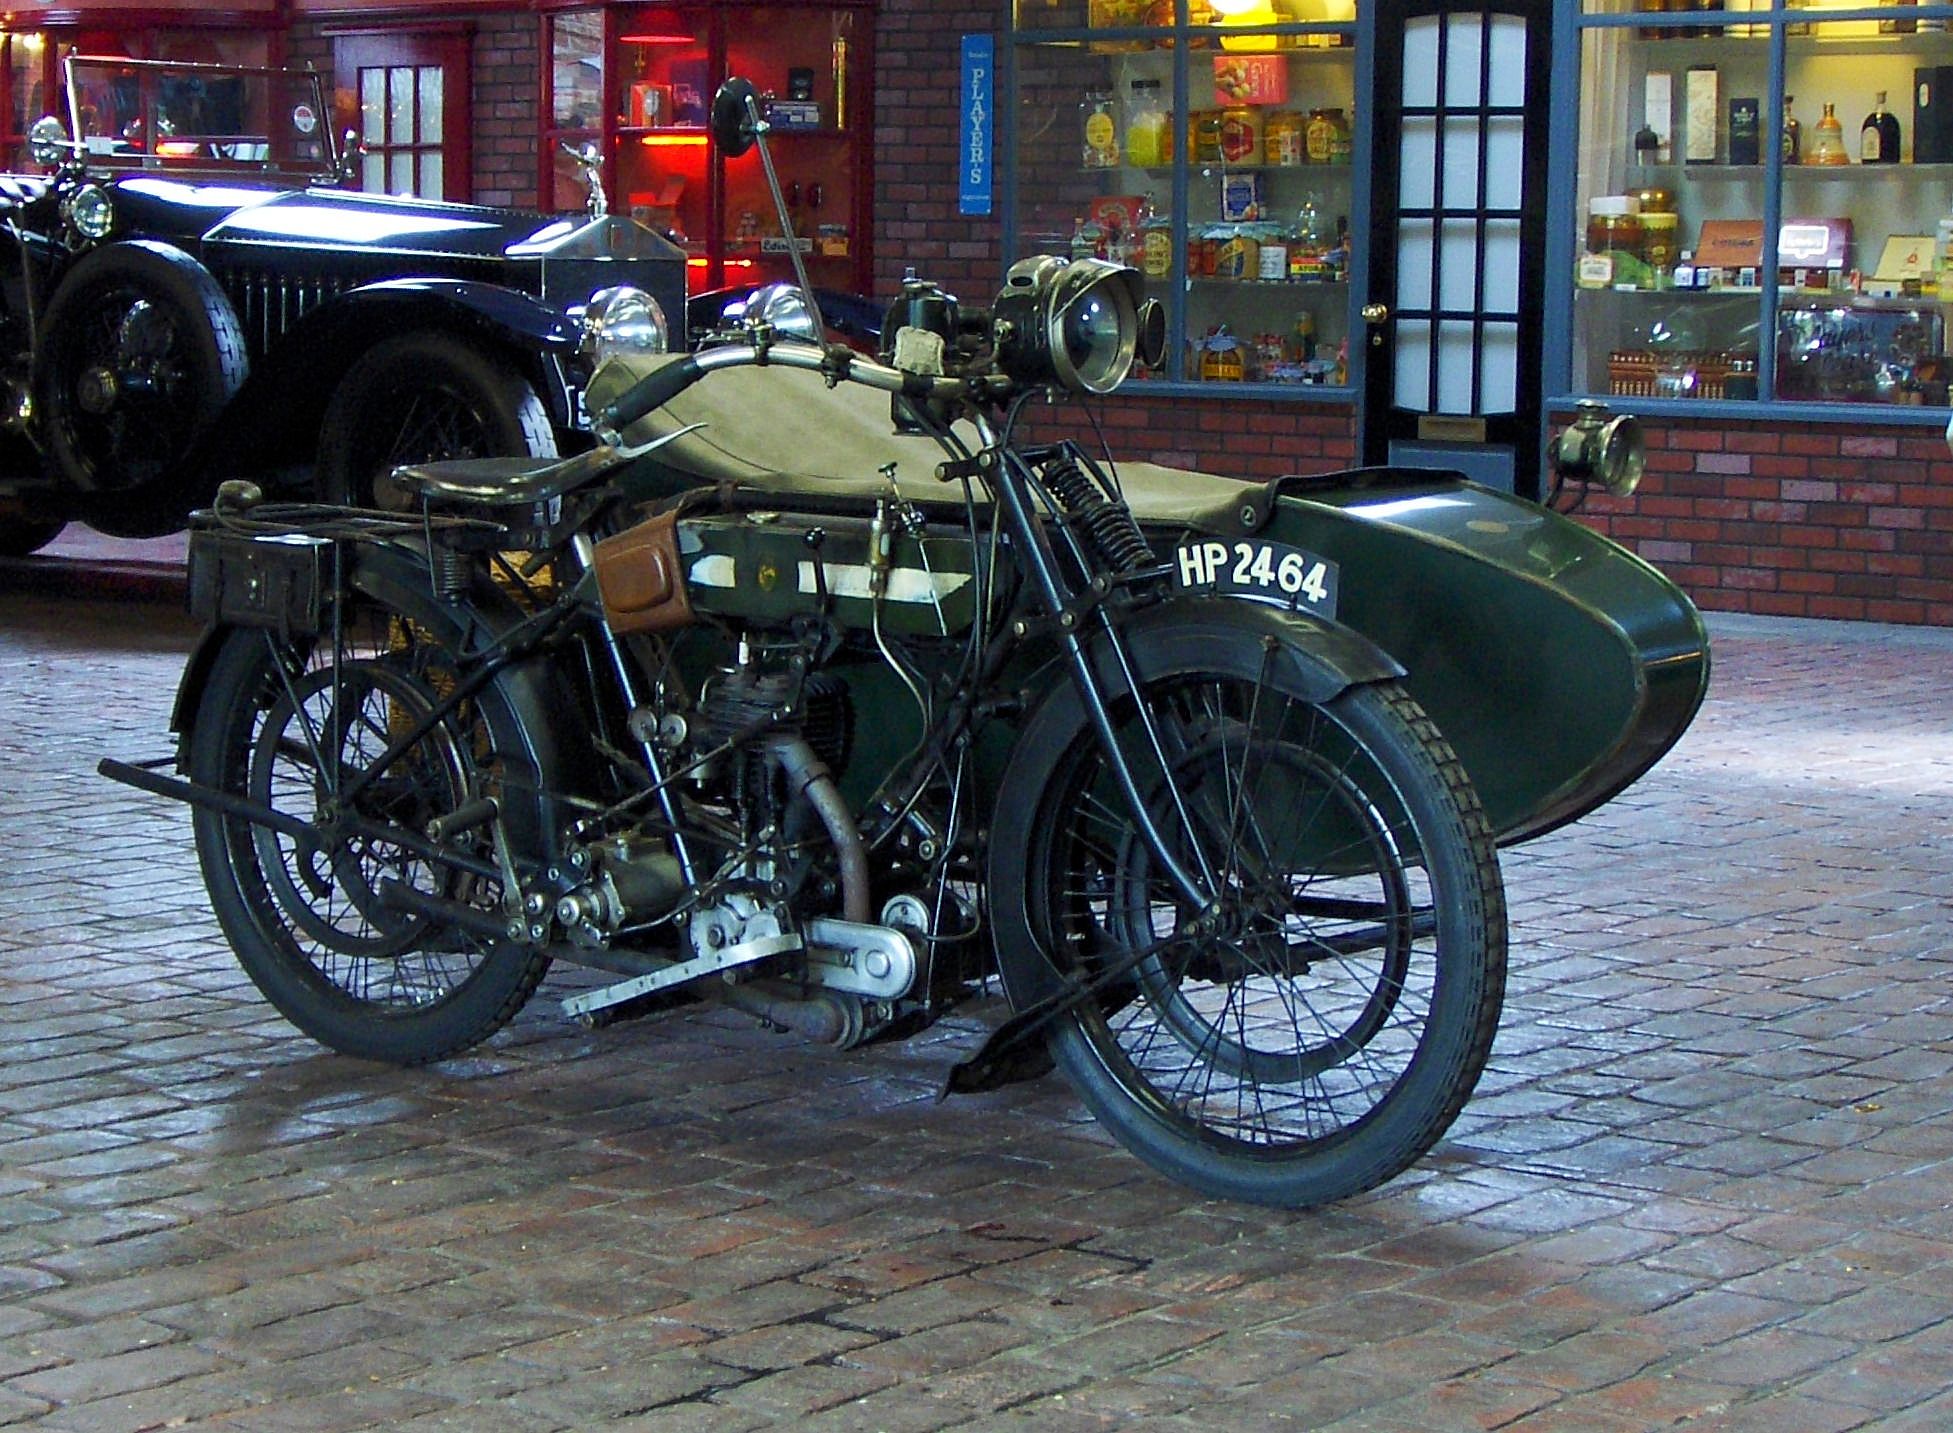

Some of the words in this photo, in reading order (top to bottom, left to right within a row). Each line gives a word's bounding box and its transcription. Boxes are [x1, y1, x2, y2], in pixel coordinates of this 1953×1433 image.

[970, 68, 986, 184] PLAYER'S
[1178, 542, 1228, 587] HP
[1232, 543, 1328, 603] 2464
